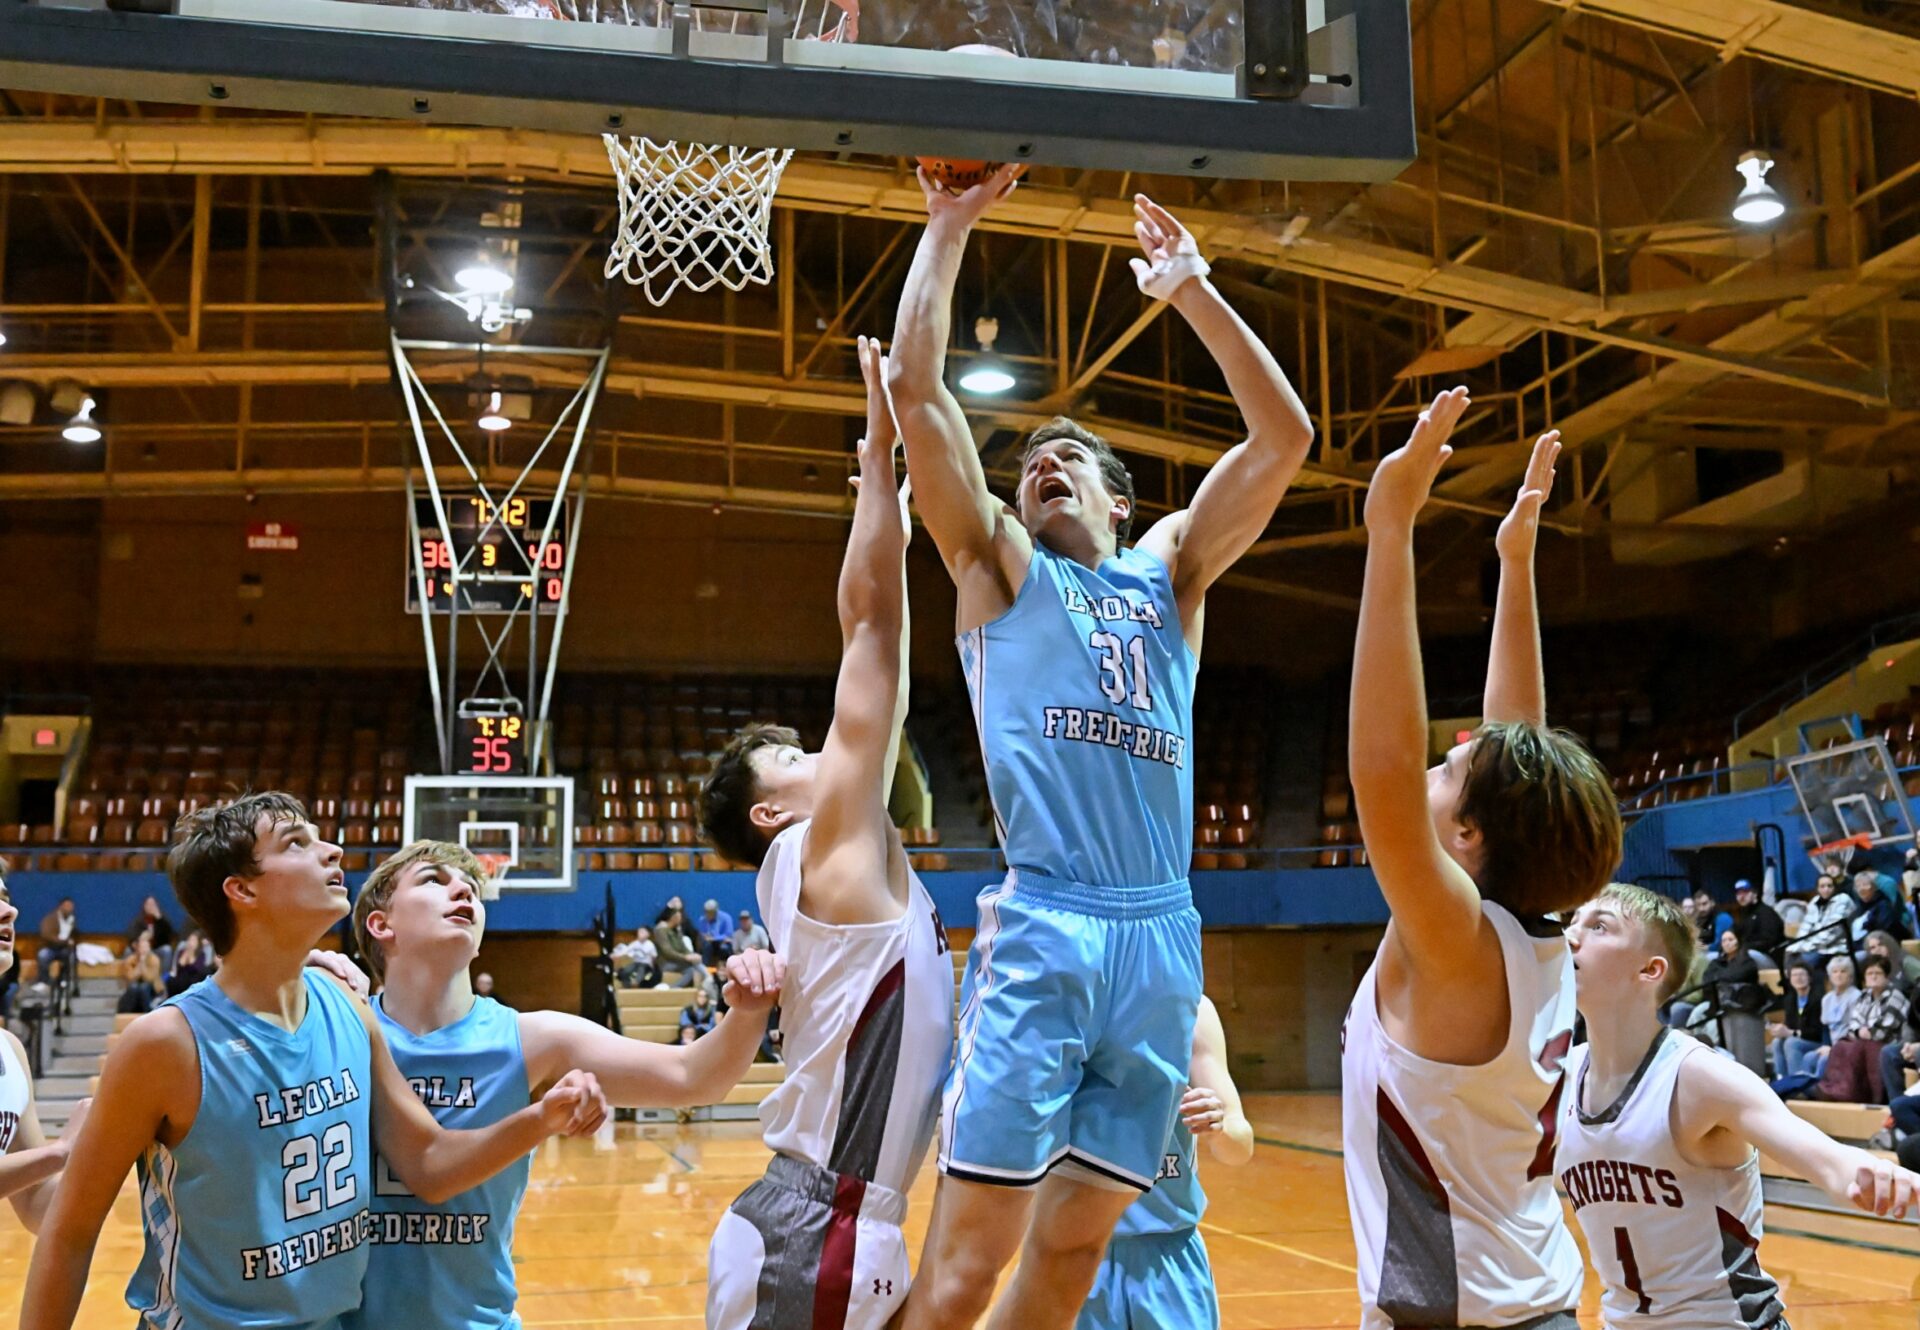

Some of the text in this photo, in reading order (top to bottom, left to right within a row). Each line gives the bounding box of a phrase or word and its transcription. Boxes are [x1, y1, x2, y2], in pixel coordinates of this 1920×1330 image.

[482, 544, 496, 567] 3
[547, 578, 562, 600] 0
[1089, 630, 1152, 711] 31
[477, 716, 521, 739] 7:12
[472, 737, 511, 772] 35
[254, 1068, 360, 1129] LEOLA
[407, 1076, 476, 1108] OLA
[281, 1121, 357, 1222] 22
[1561, 1159, 1684, 1213] KNIGHTS
[241, 1208, 370, 1280] FREDERIC
[369, 1212, 490, 1244] EDERICK
[1614, 1226, 1652, 1314] 1
